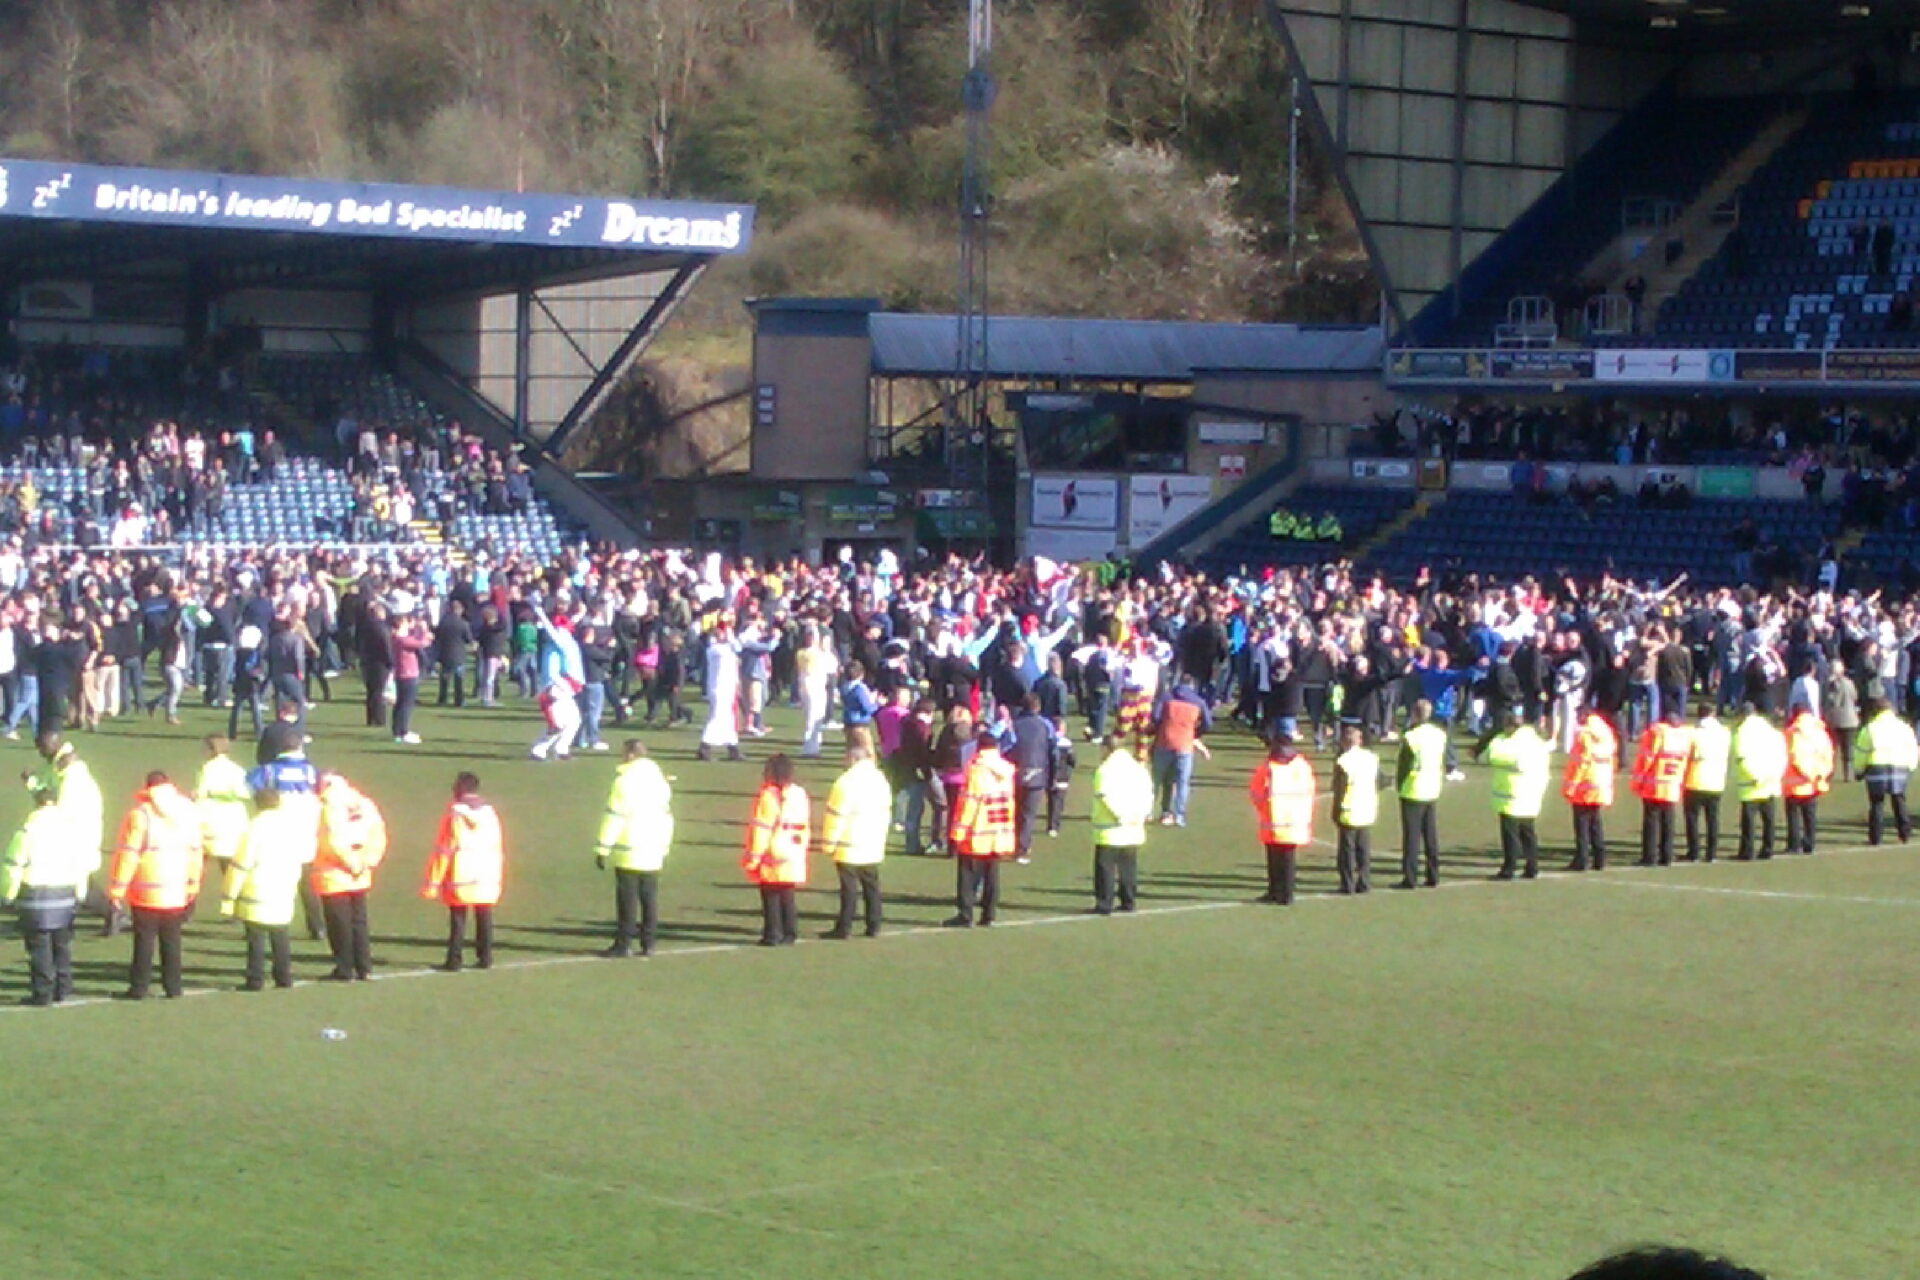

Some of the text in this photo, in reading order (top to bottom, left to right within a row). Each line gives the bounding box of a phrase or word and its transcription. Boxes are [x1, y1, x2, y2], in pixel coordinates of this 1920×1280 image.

[95, 183, 219, 217] Britain's
[224, 190, 332, 227] leading
[337, 198, 392, 224] Bed
[396, 201, 528, 231] Specialist
[601, 201, 743, 249] Dreams
